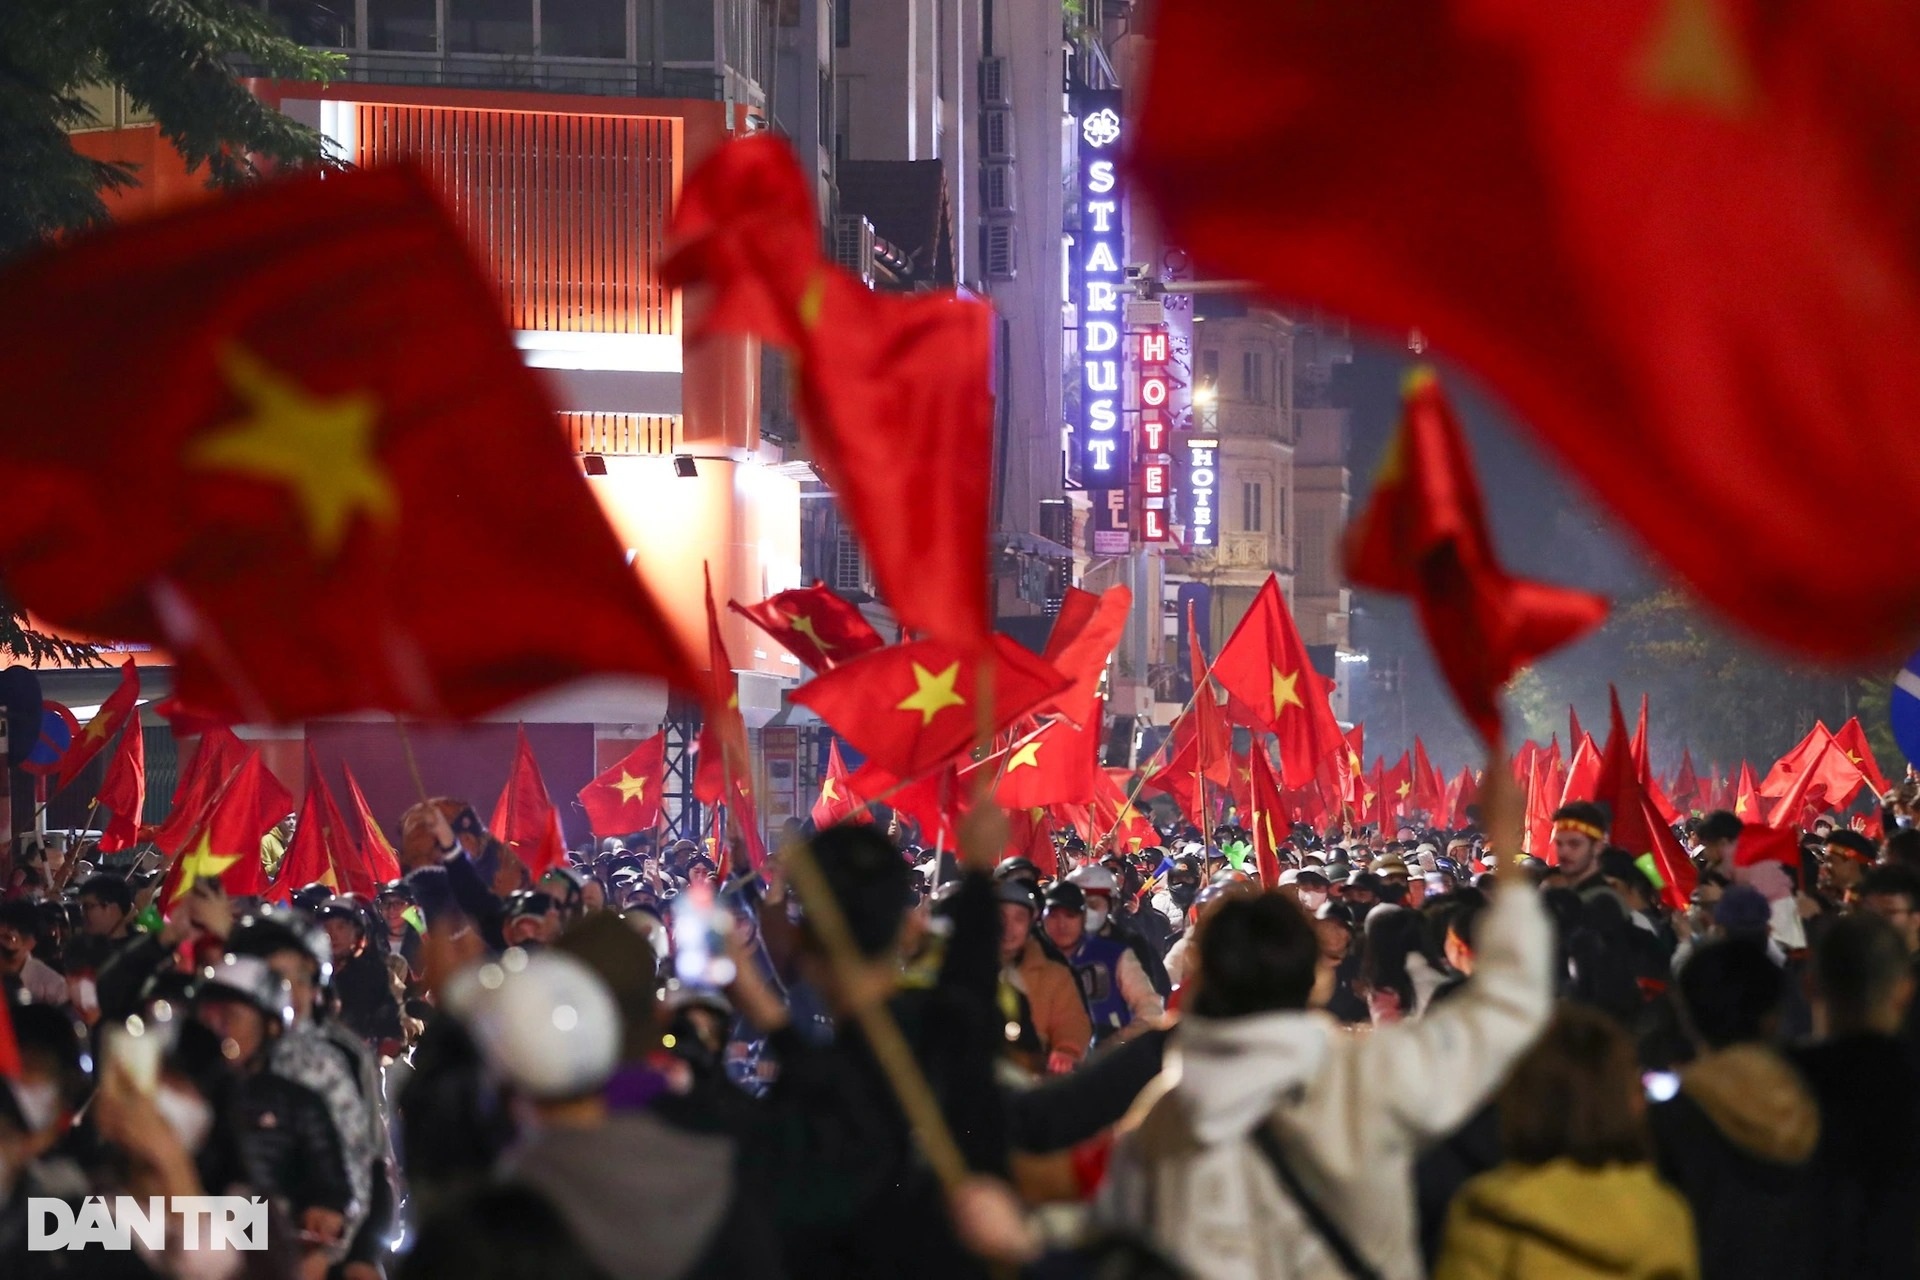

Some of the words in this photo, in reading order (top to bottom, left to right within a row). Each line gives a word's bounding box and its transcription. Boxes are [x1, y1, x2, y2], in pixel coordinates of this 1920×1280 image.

[1085, 162, 1118, 470] STARDUST
[1143, 335, 1165, 538] HOTEL
[1191, 448, 1214, 545] HOTEL
